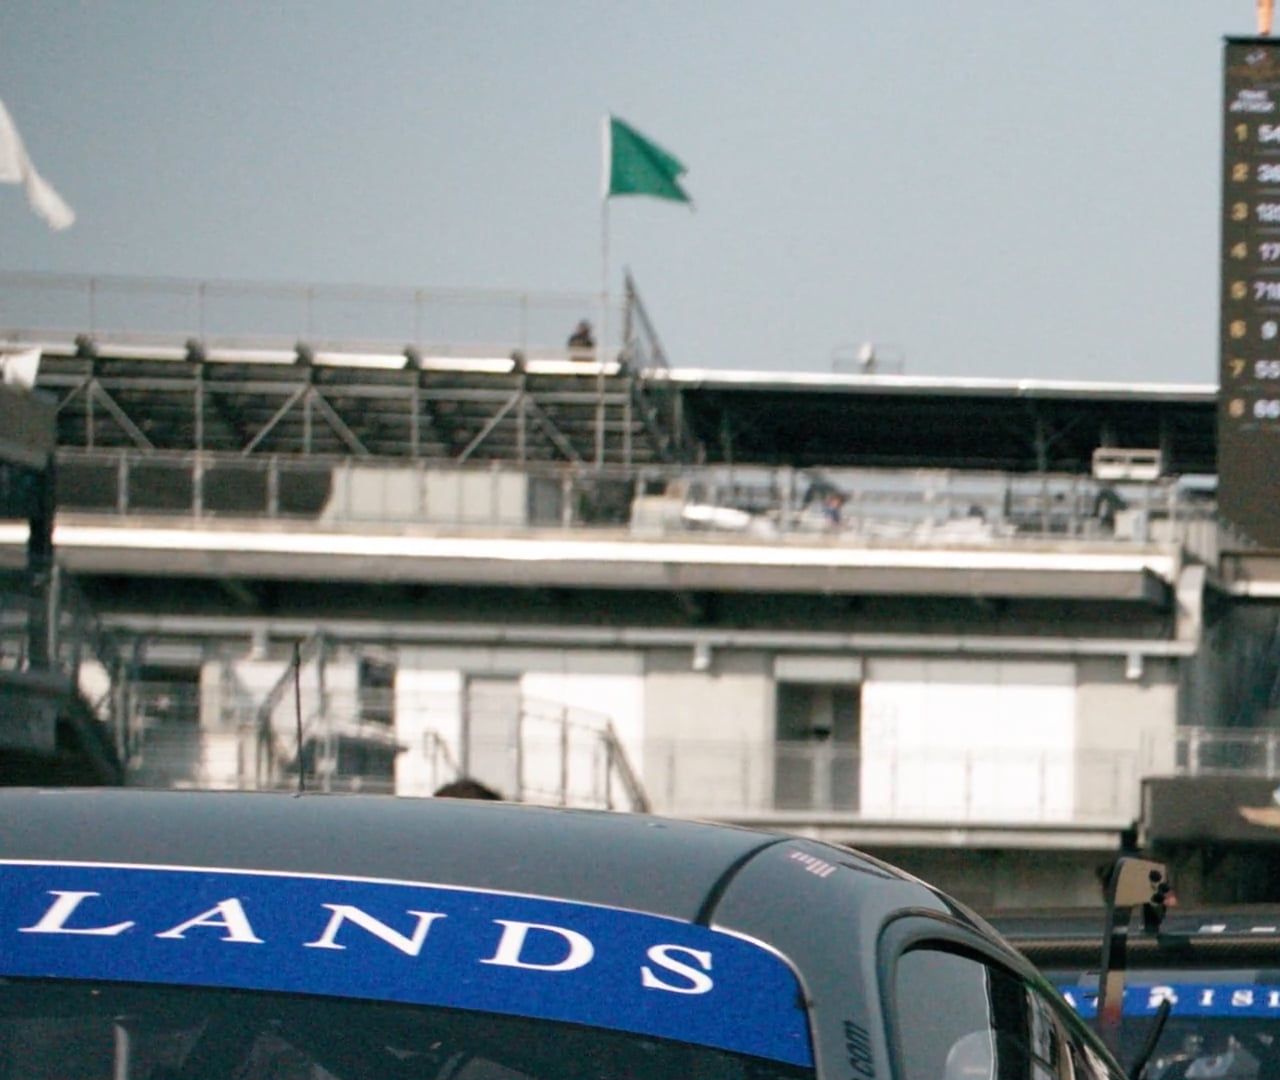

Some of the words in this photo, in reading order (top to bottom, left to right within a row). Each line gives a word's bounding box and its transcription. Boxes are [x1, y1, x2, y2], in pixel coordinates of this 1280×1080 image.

[1234, 123, 1248, 142] 1
[1230, 242, 1247, 260] 4
[1229, 360, 1246, 379] 7
[19, 889, 716, 996] LANDS
